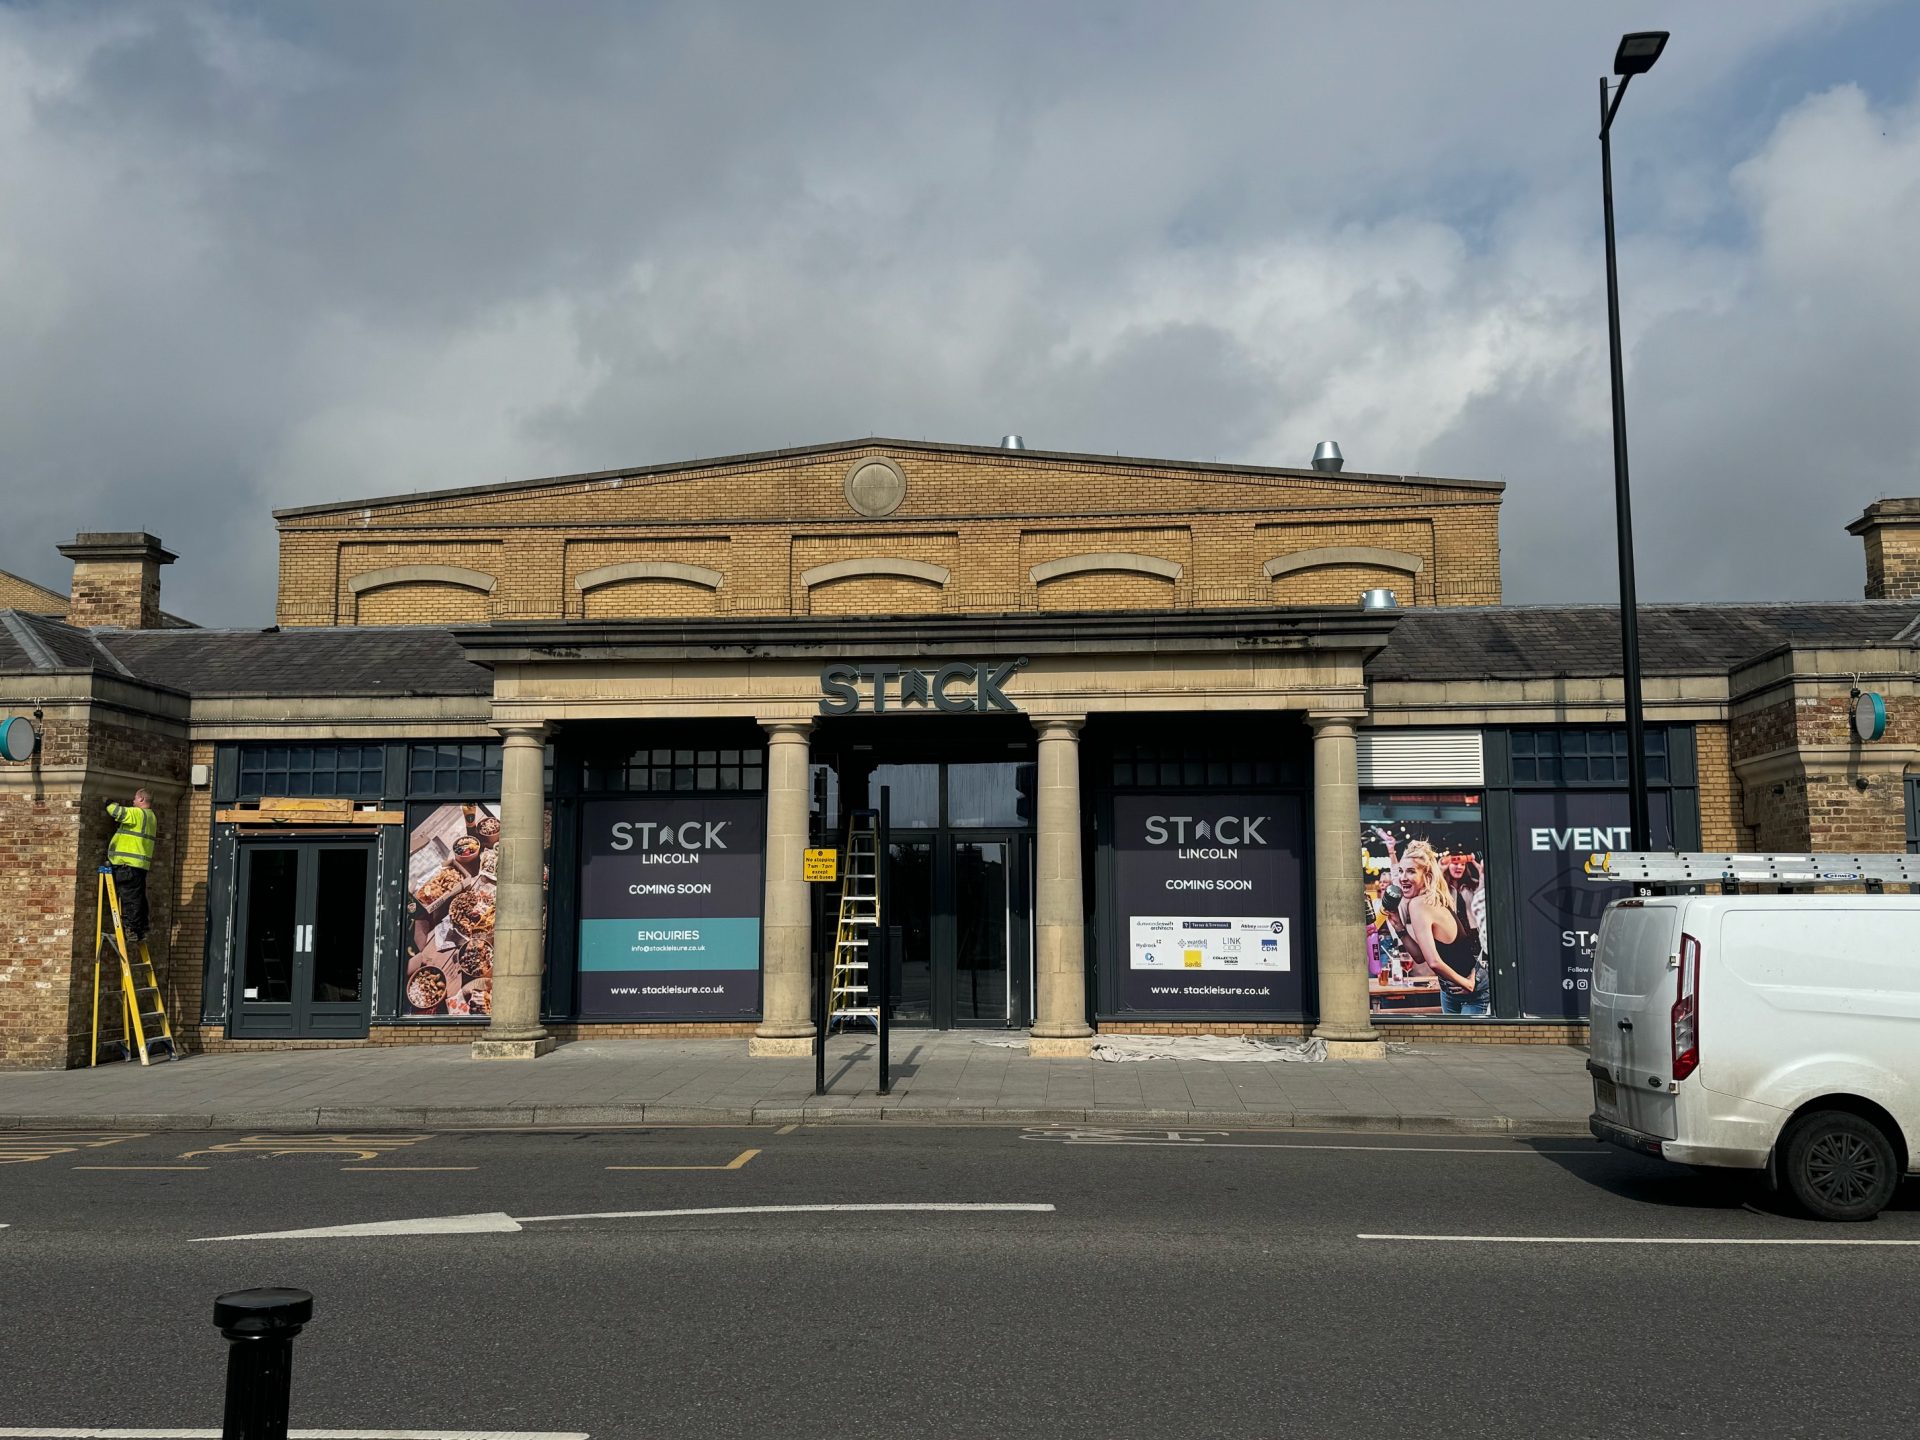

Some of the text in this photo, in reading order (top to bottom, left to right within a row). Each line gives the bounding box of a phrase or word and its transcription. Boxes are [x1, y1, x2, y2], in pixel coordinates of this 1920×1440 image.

[1531, 827, 1652, 851] EVENT
[642, 853, 699, 864] LINCOLN
[1178, 848, 1238, 859] LINCOLN
[629, 884, 712, 894] COMING SOON
[1165, 880, 1252, 890] COMING SOON
[1640, 888, 1652, 896] 9a
[638, 930, 700, 941] ENQUIRIES
[631, 944, 706, 952] info@stackleisure.co.uk
